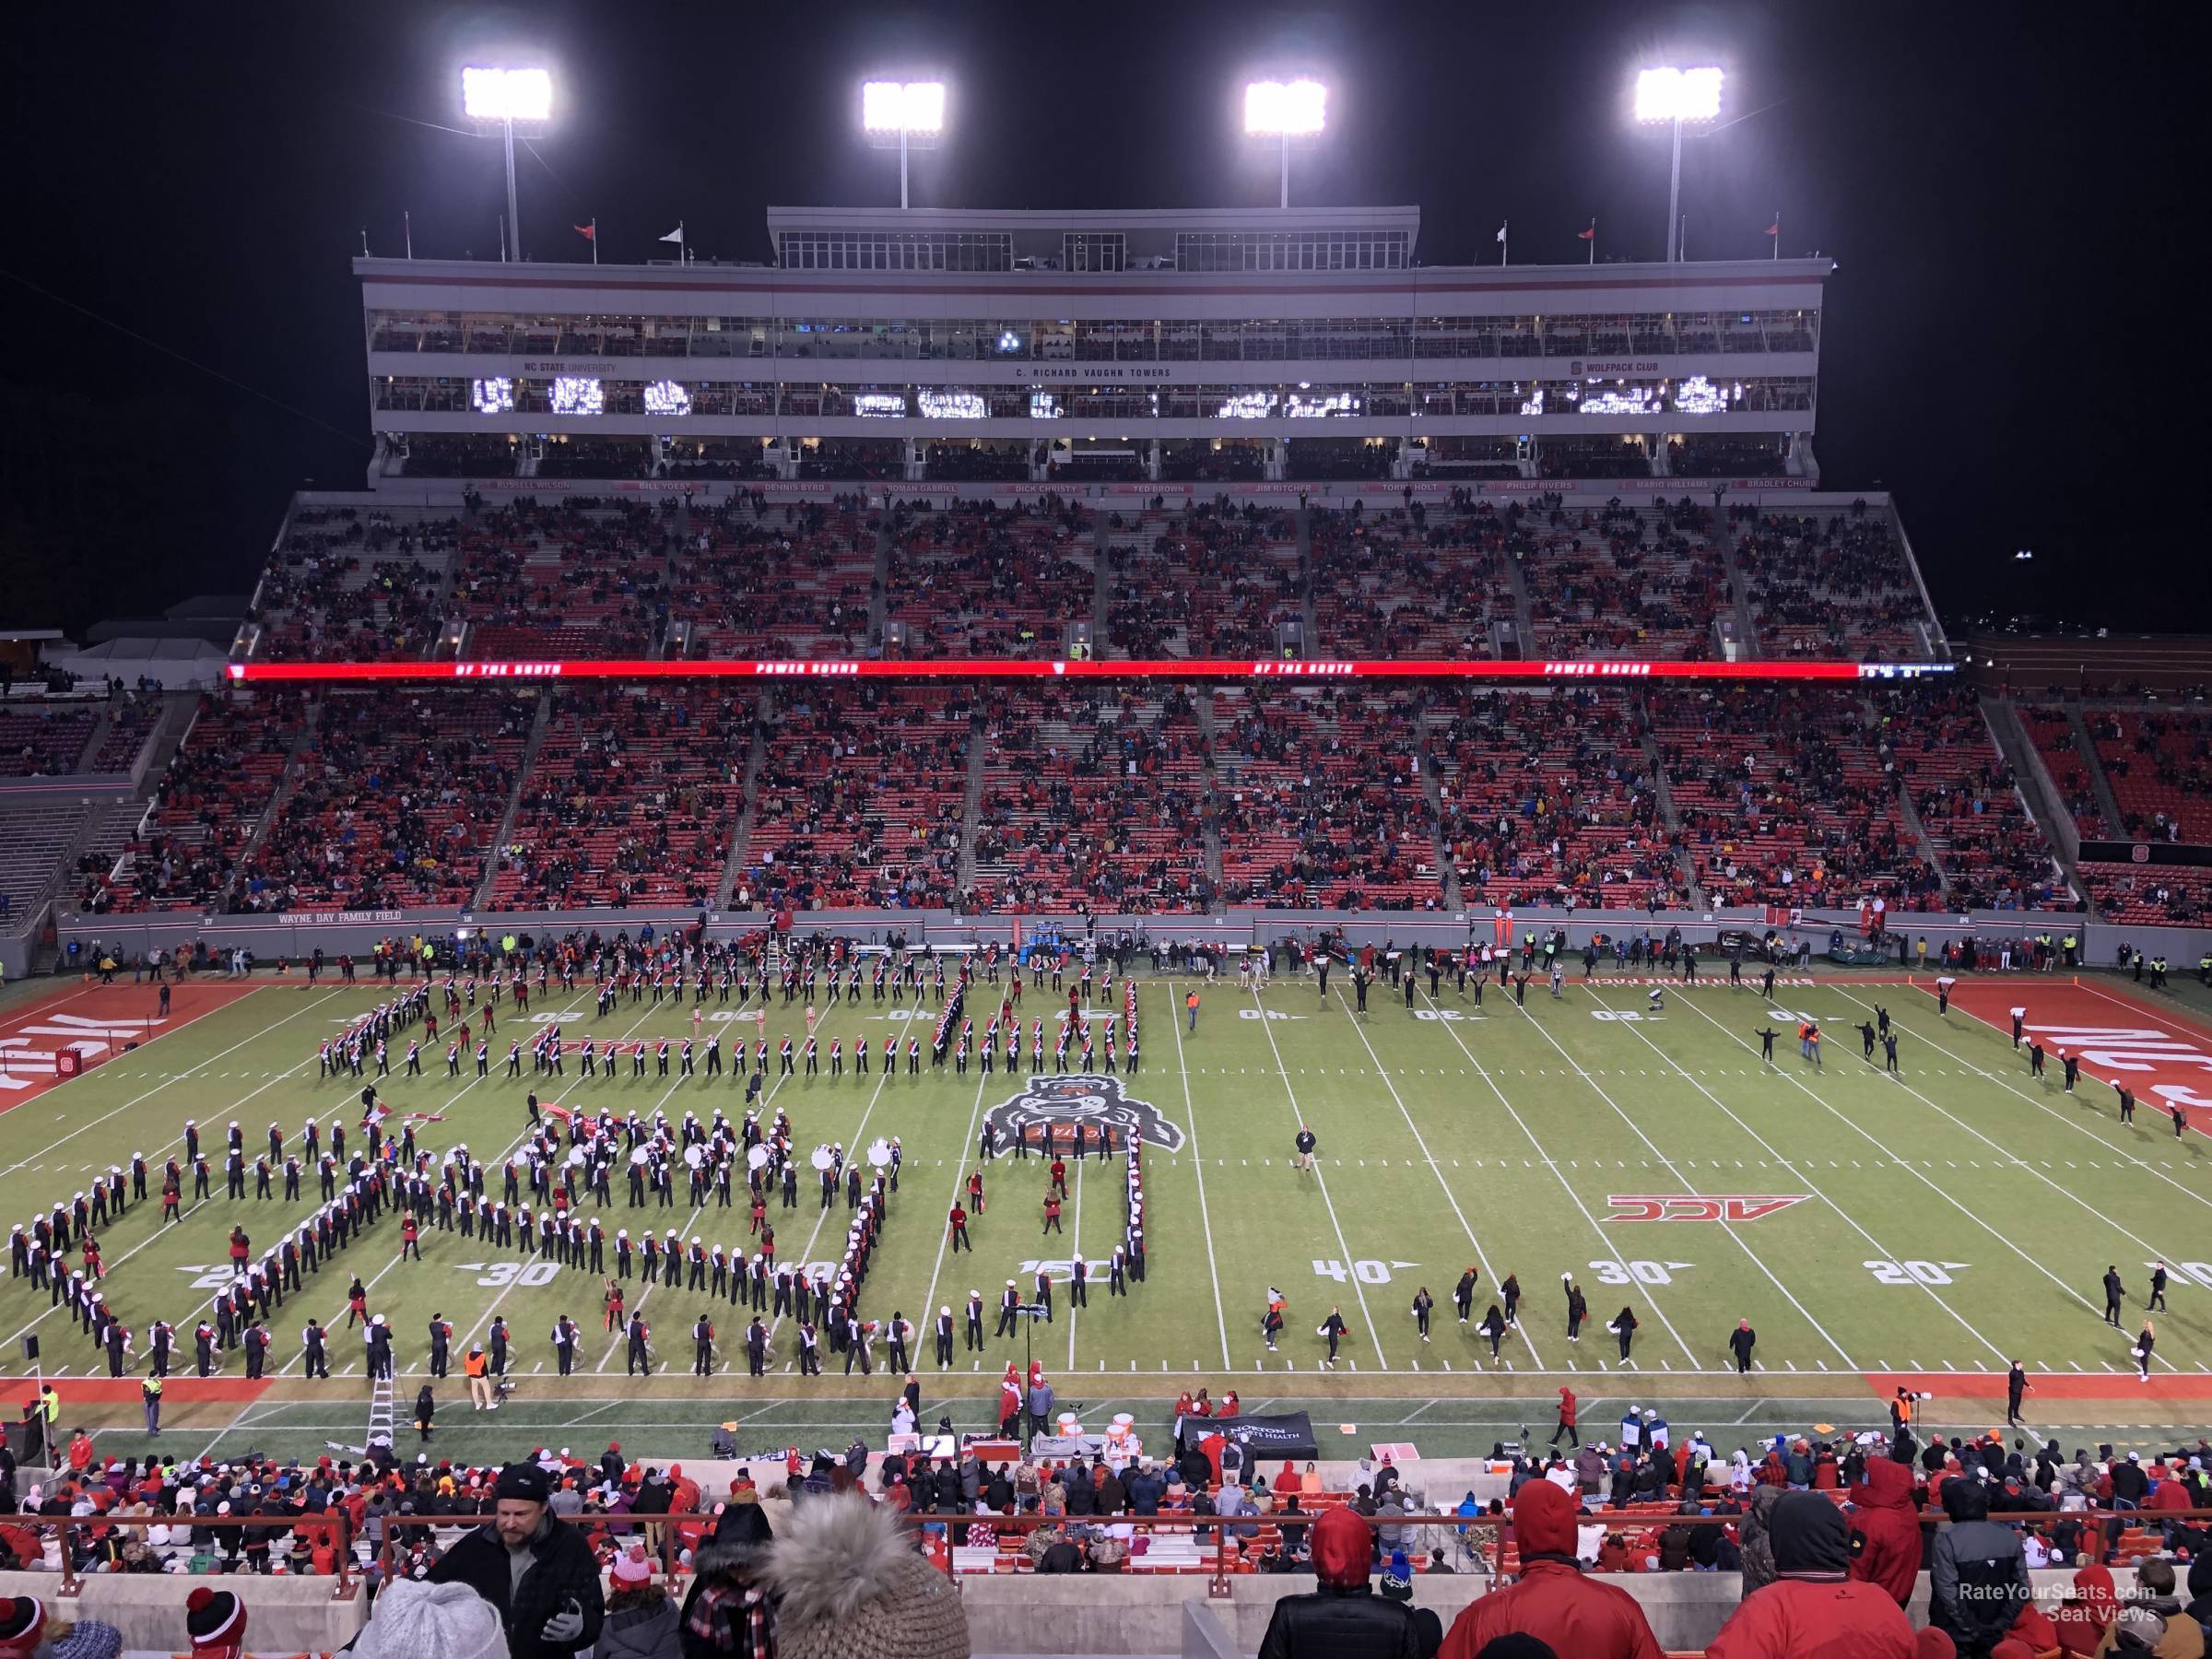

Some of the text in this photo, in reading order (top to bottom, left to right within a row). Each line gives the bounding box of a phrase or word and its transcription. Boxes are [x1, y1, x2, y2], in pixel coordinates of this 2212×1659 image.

[524, 362, 617, 372] NC STATE UNIVERSITY
[1586, 362, 1634, 372] WOLFPACK
[1636, 361, 1659, 371] CLUB
[1017, 369, 1171, 377] C. RICHARD VAUGHN TOWERS
[497, 481, 570, 489] RUSSELL WILSON
[640, 482, 659, 490] BILL
[1414, 483, 1437, 491] HOLT
[1636, 480, 1708, 488] MARIO WILLIAMS
[1787, 479, 1816, 488] CHUBB
[756, 664, 805, 674] POWER
[1278, 664, 1303, 674] THE
[1545, 664, 1594, 674] POWER
[278, 911, 402, 924] WAYNE DAY FAMILY FIELD
[530, 1012, 583, 1023] 20
[888, 1009, 936, 1020] 40
[1238, 1009, 1288, 1020] 40
[1414, 1009, 1465, 1020] 30
[1591, 1010, 1643, 1021] 20
[1767, 1011, 1820, 1021] 10
[1597, 1194, 1816, 1222] ACC
[477, 1262, 561, 1288] 30
[1312, 1260, 1392, 1284] 40
[1588, 1261, 1672, 1285] 30
[1863, 1261, 1953, 1285] 20
[1230, 1424, 1286, 1434] NORTON
[2037, 1547, 2047, 1559] 19
